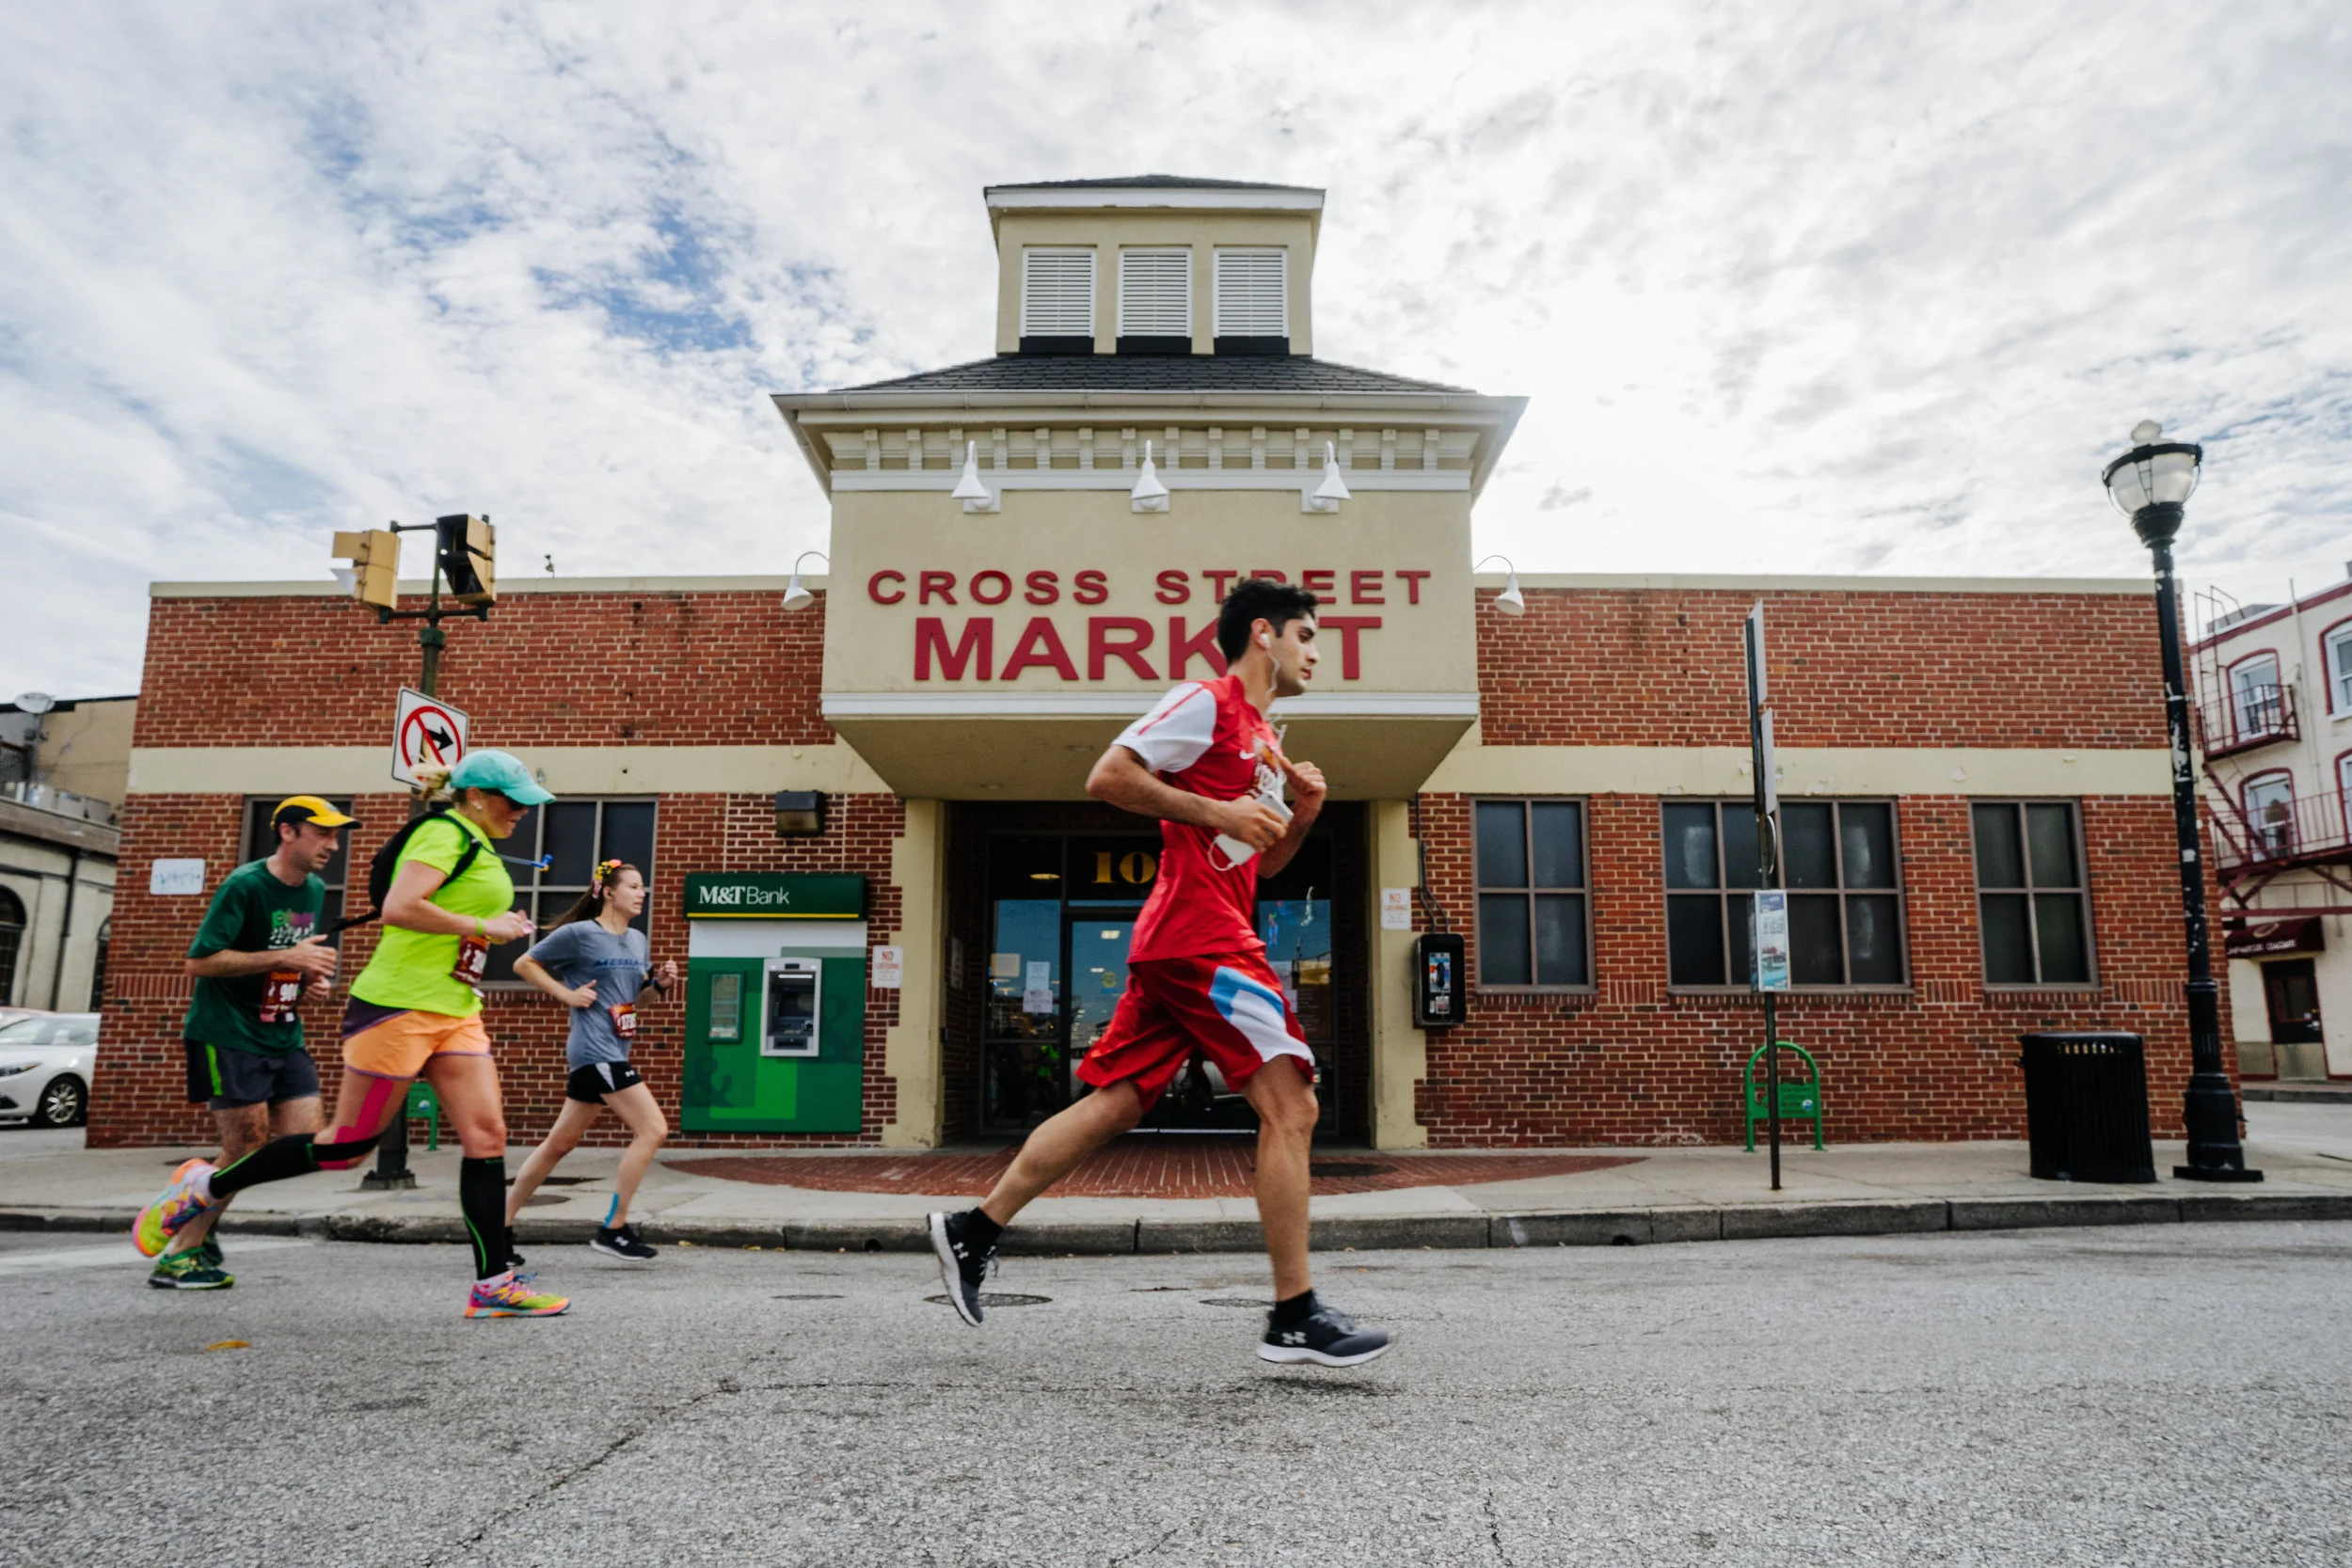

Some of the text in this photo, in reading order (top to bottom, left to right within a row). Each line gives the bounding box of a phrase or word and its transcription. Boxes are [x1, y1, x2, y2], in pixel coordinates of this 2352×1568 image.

[867, 570, 1109, 605] CROSS
[914, 616, 1382, 681] MARKT
[699, 886, 789, 905] M&T Bank
[594, 958, 641, 968] MESSIA
